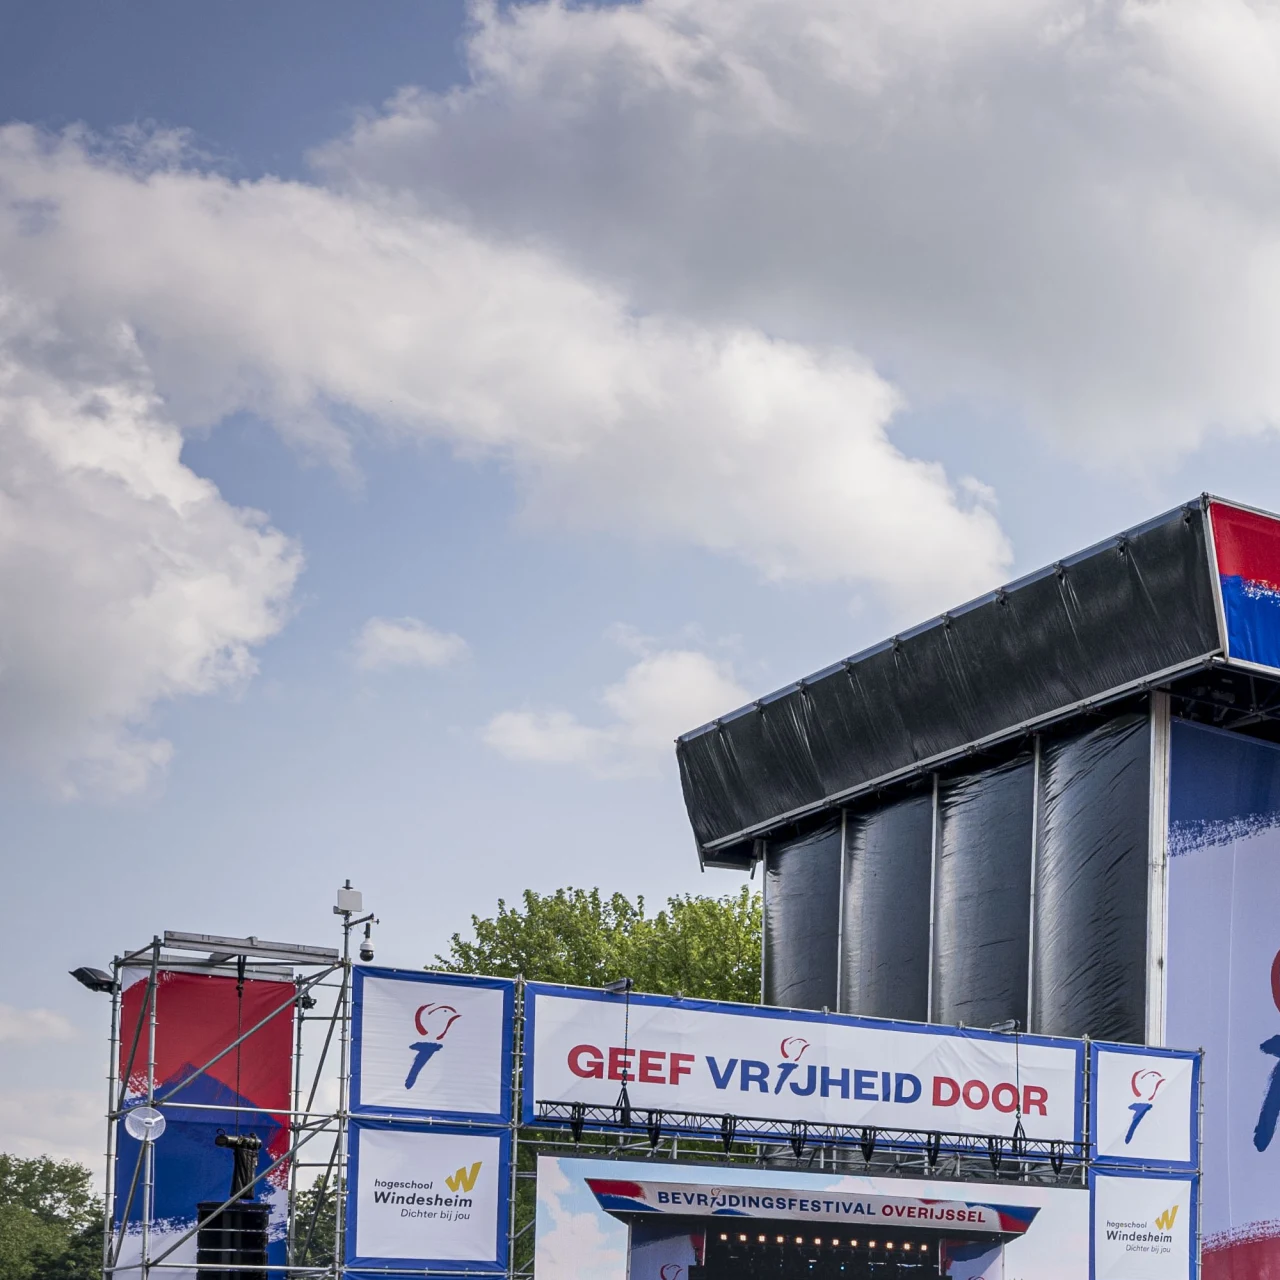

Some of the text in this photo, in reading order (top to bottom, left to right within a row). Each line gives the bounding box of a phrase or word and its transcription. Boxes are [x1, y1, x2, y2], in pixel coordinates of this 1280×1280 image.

[567, 1044, 1048, 1117] GEEF VRIJHEID DOOR
[374, 1178, 433, 1190] hogeschool
[373, 1191, 473, 1208] Windesheim
[657, 1190, 986, 1224] BEVRIJDINGSFESTIVAL OVERIJSSEL
[400, 1208, 471, 1221] Dichter bij jou
[1106, 1220, 1148, 1229] hogeschool
[1106, 1230, 1172, 1243] Windesheim
[1125, 1244, 1150, 1252] Dichter
[1150, 1245, 1160, 1254] bij
